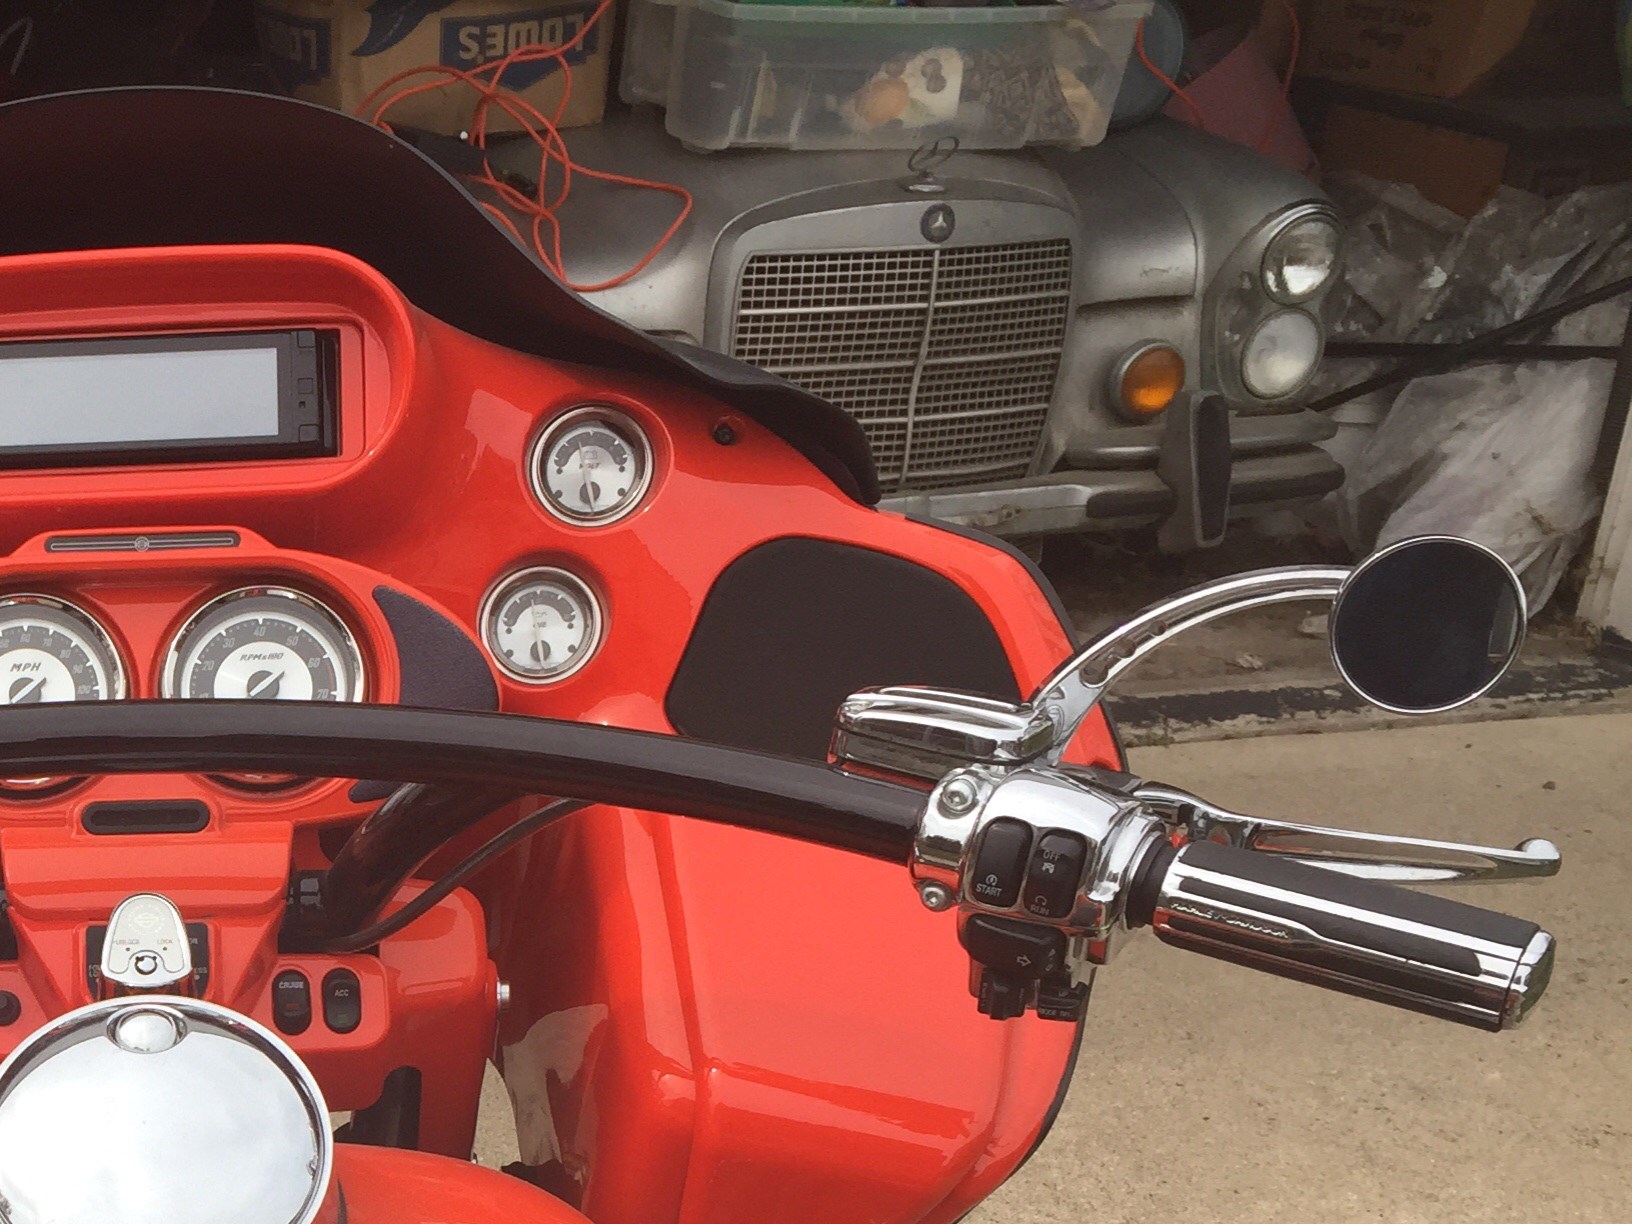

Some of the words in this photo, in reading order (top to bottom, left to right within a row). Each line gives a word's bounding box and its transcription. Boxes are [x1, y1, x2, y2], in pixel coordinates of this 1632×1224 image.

[10, 662, 41, 673] MPH
[1043, 850, 1062, 861] OFF
[976, 883, 1002, 897] START
[334, 989, 349, 997] ACC
